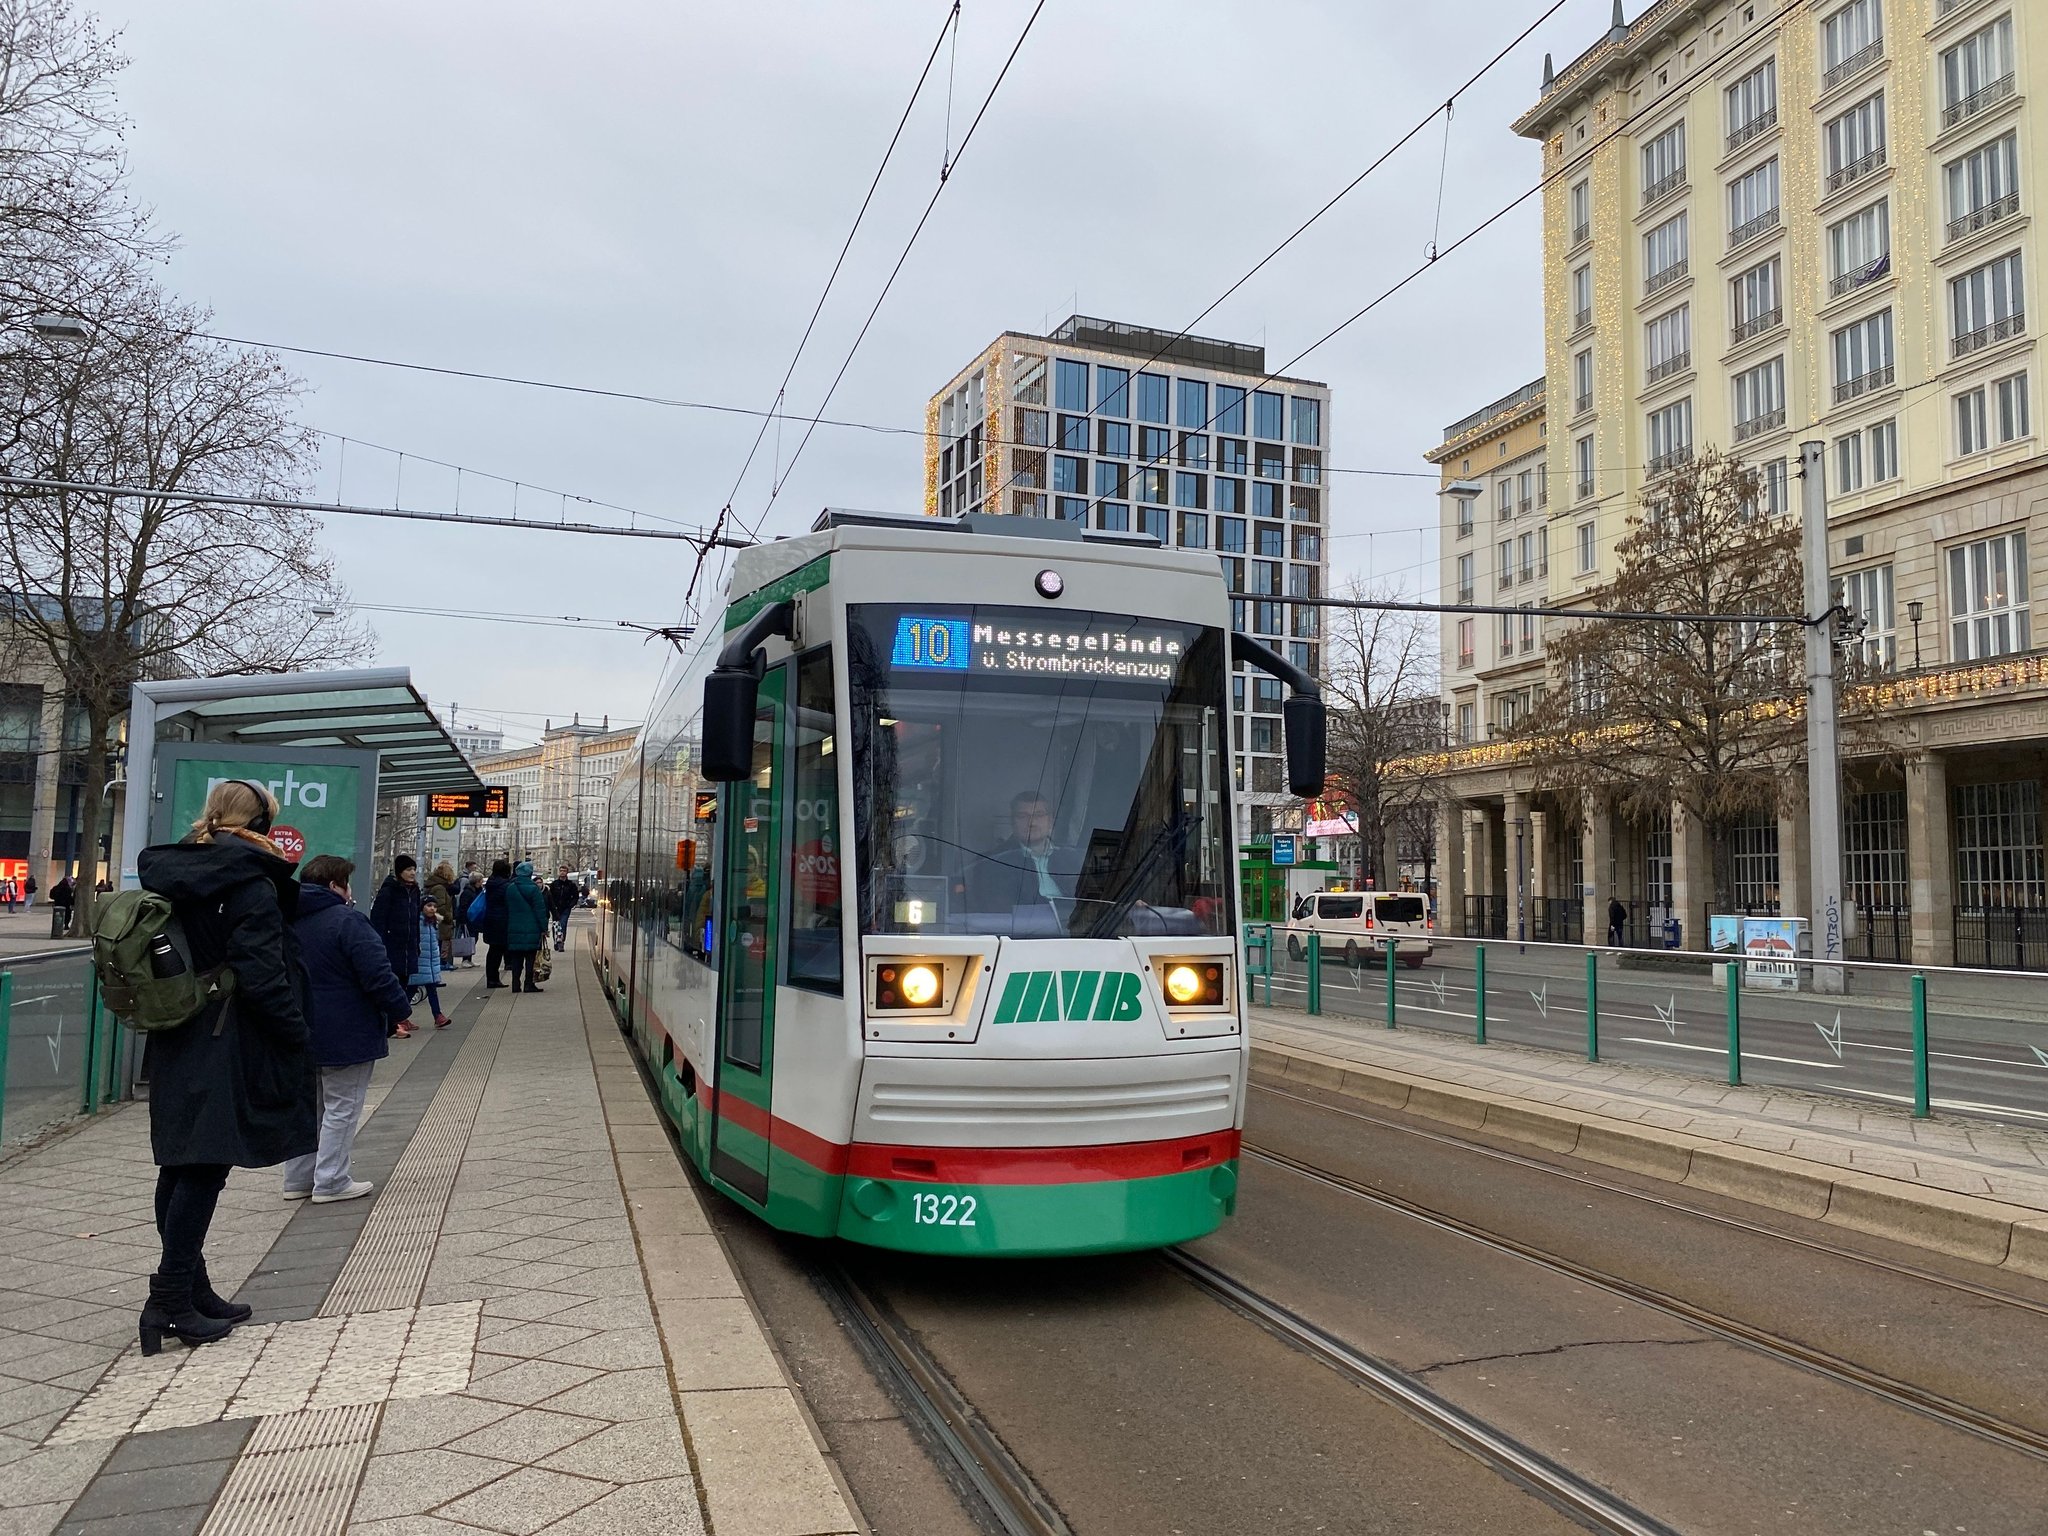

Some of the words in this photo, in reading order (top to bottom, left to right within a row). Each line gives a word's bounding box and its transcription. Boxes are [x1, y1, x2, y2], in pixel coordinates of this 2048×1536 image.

[909, 622, 949, 662] 10
[973, 624, 1180, 655] Messegelände
[983, 652, 999, 669] ü.
[1006, 651, 1171, 680] Strombrückenzug
[909, 900, 922, 924] 6
[993, 970, 1142, 1024] MVB
[913, 1193, 977, 1226] 1322
